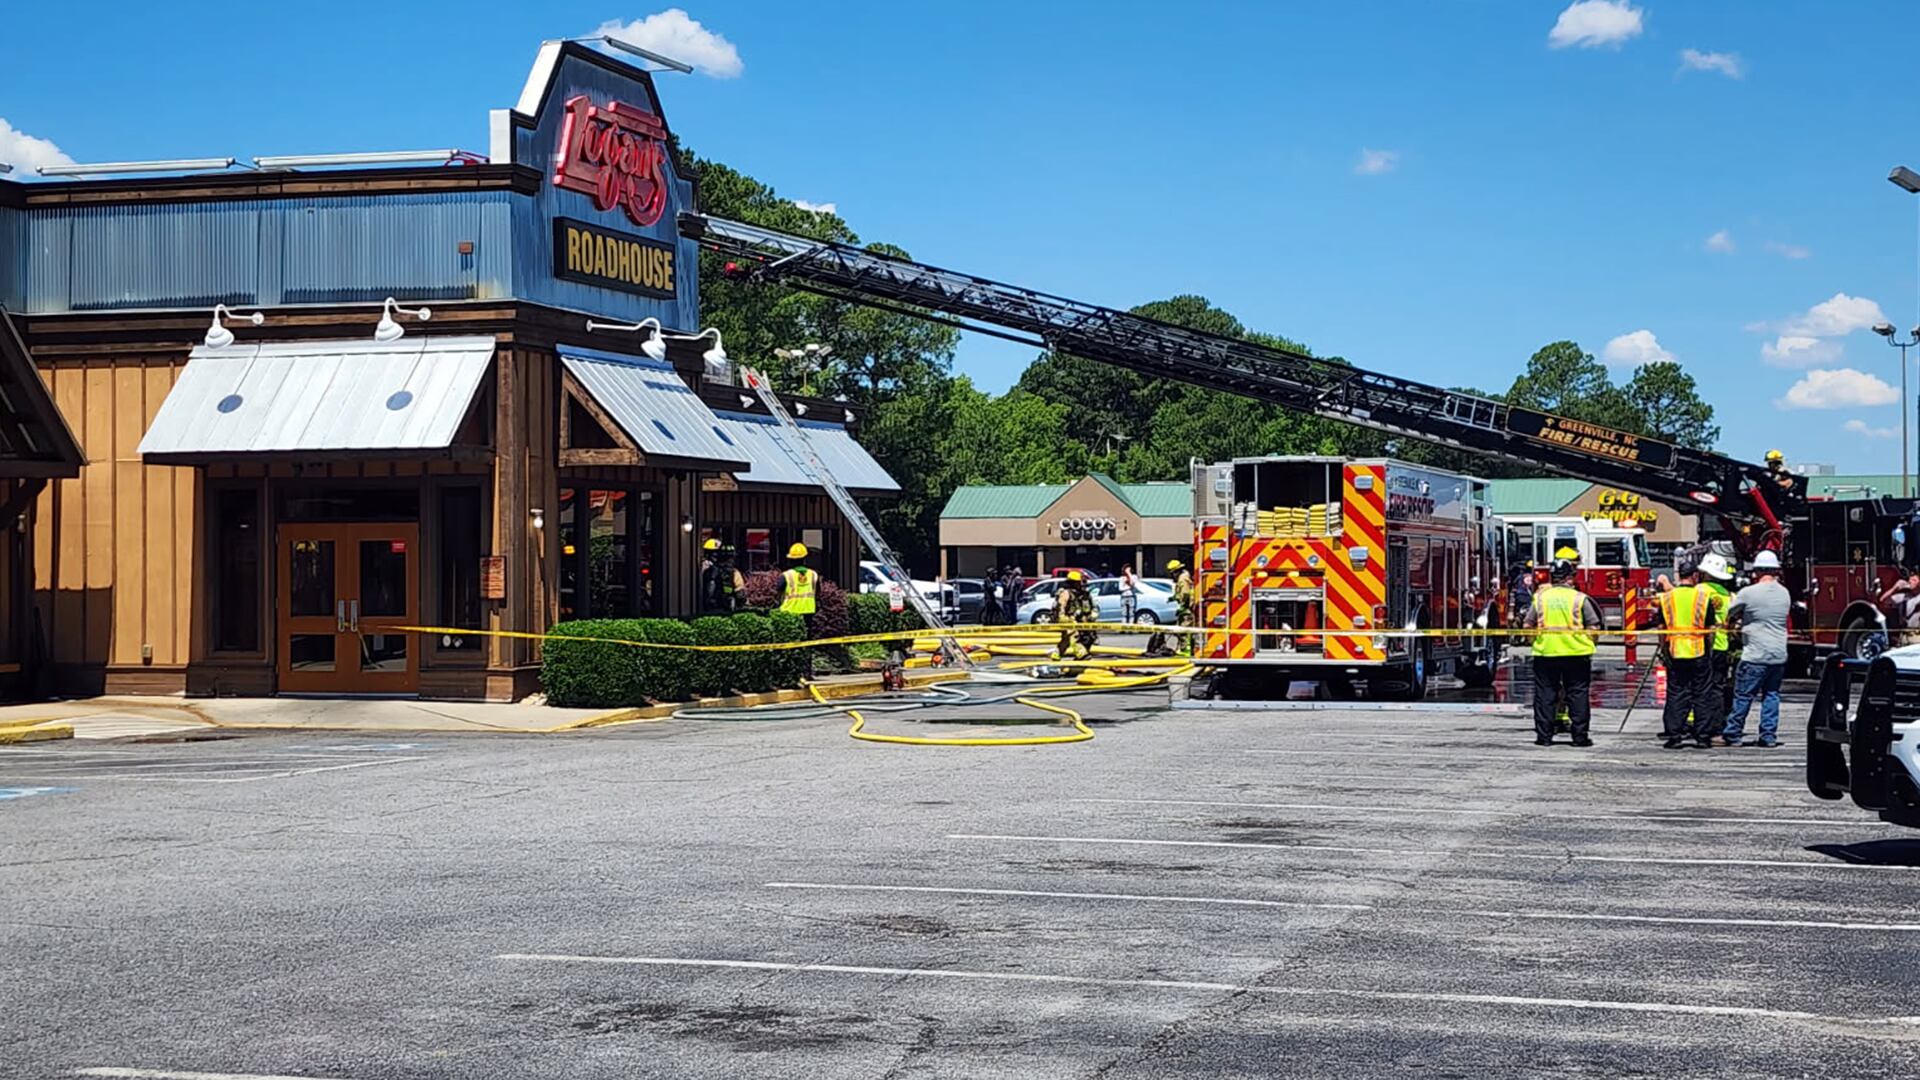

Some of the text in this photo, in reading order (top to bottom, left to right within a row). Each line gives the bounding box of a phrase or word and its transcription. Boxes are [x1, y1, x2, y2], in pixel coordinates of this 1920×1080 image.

[567, 227, 674, 291] ROADHOUSE
[1538, 427, 1640, 460] FIRE/RESCUE
[1623, 434, 1639, 447] NC
[1060, 518, 1116, 530] COCO'S
